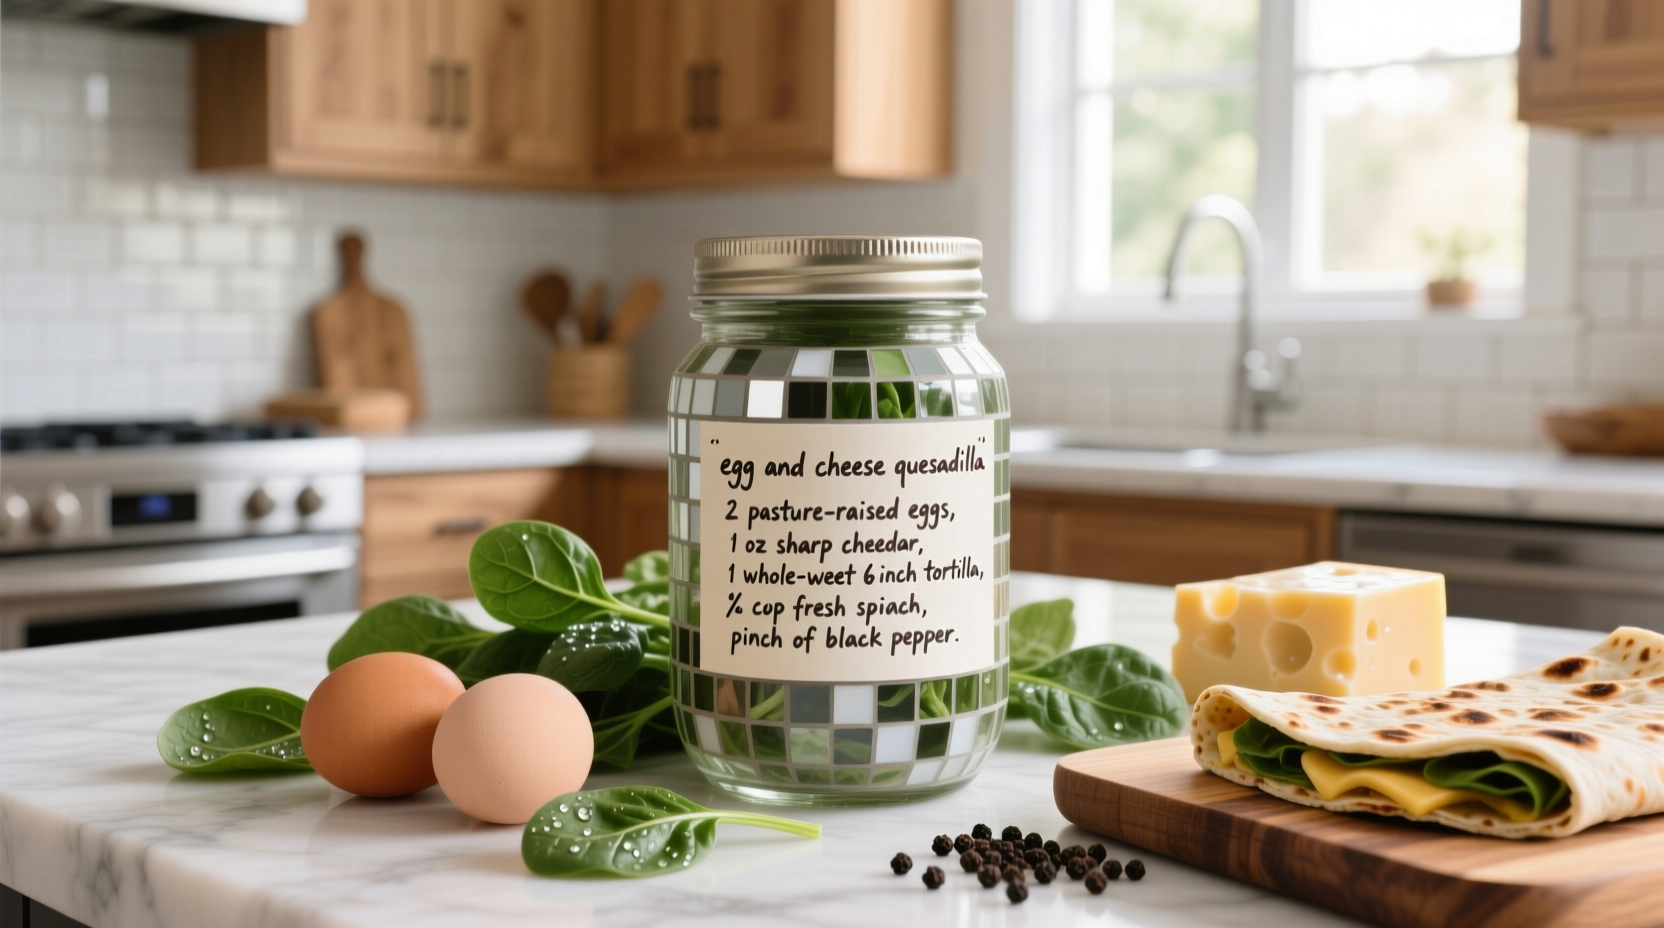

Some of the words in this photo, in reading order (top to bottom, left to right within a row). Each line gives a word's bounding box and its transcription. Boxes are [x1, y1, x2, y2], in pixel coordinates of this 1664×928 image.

[764, 450, 806, 478] and
[814, 450, 886, 478] cheese
[724, 498, 739, 521] 2
[747, 496, 900, 531] pasture-raised
[908, 502, 956, 530] eggs,
[730, 532, 738, 554] 1
[745, 538, 767, 554] oz
[776, 530, 833, 564] sharp
[841, 530, 924, 556] cheedar,
[728, 562, 736, 584] 1
[743, 562, 857, 586] whole-weet
[923, 555, 985, 582] tortilla,
[792, 594, 846, 622] fresh
[856, 592, 928, 627] spiach,
[730, 625, 783, 656] pinch
[792, 625, 818, 654] of
[825, 625, 883, 649] black
[890, 629, 960, 657] pepper.
